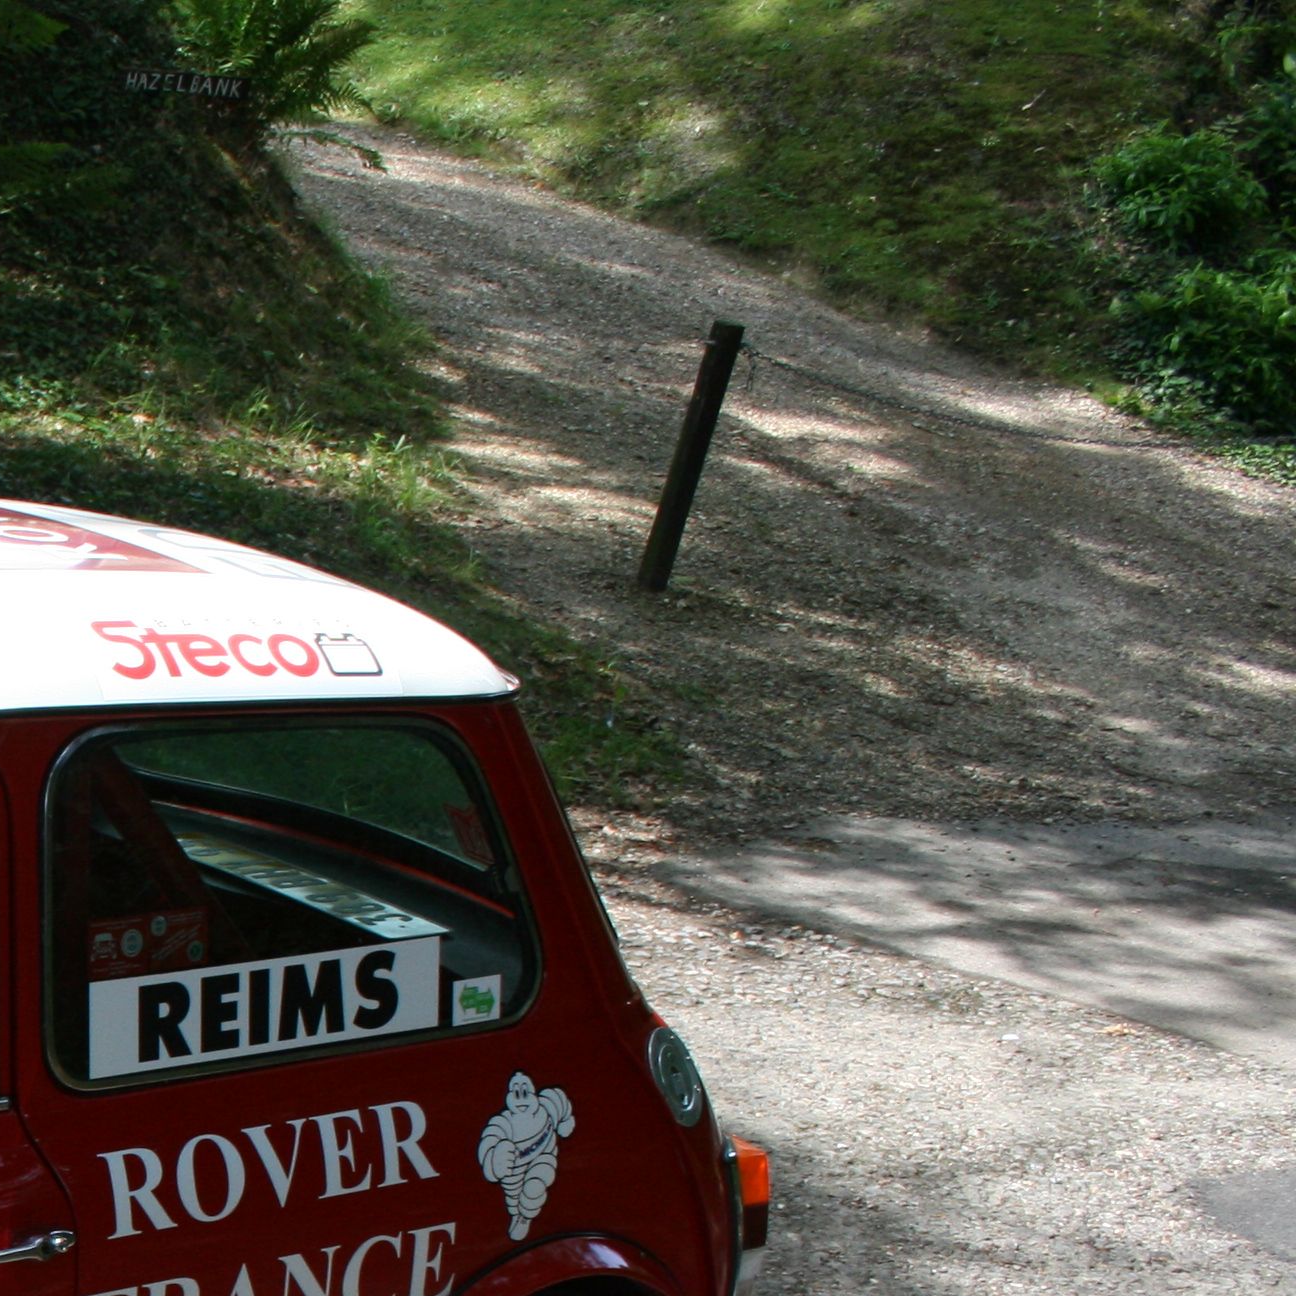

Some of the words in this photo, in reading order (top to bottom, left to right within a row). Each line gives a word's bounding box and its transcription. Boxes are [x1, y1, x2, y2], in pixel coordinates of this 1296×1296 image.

[125, 72, 243, 98] HAZELBANK
[91, 620, 320, 681] Steco
[137, 949, 401, 1064] REIMS
[96, 1100, 440, 1242] ROVER
